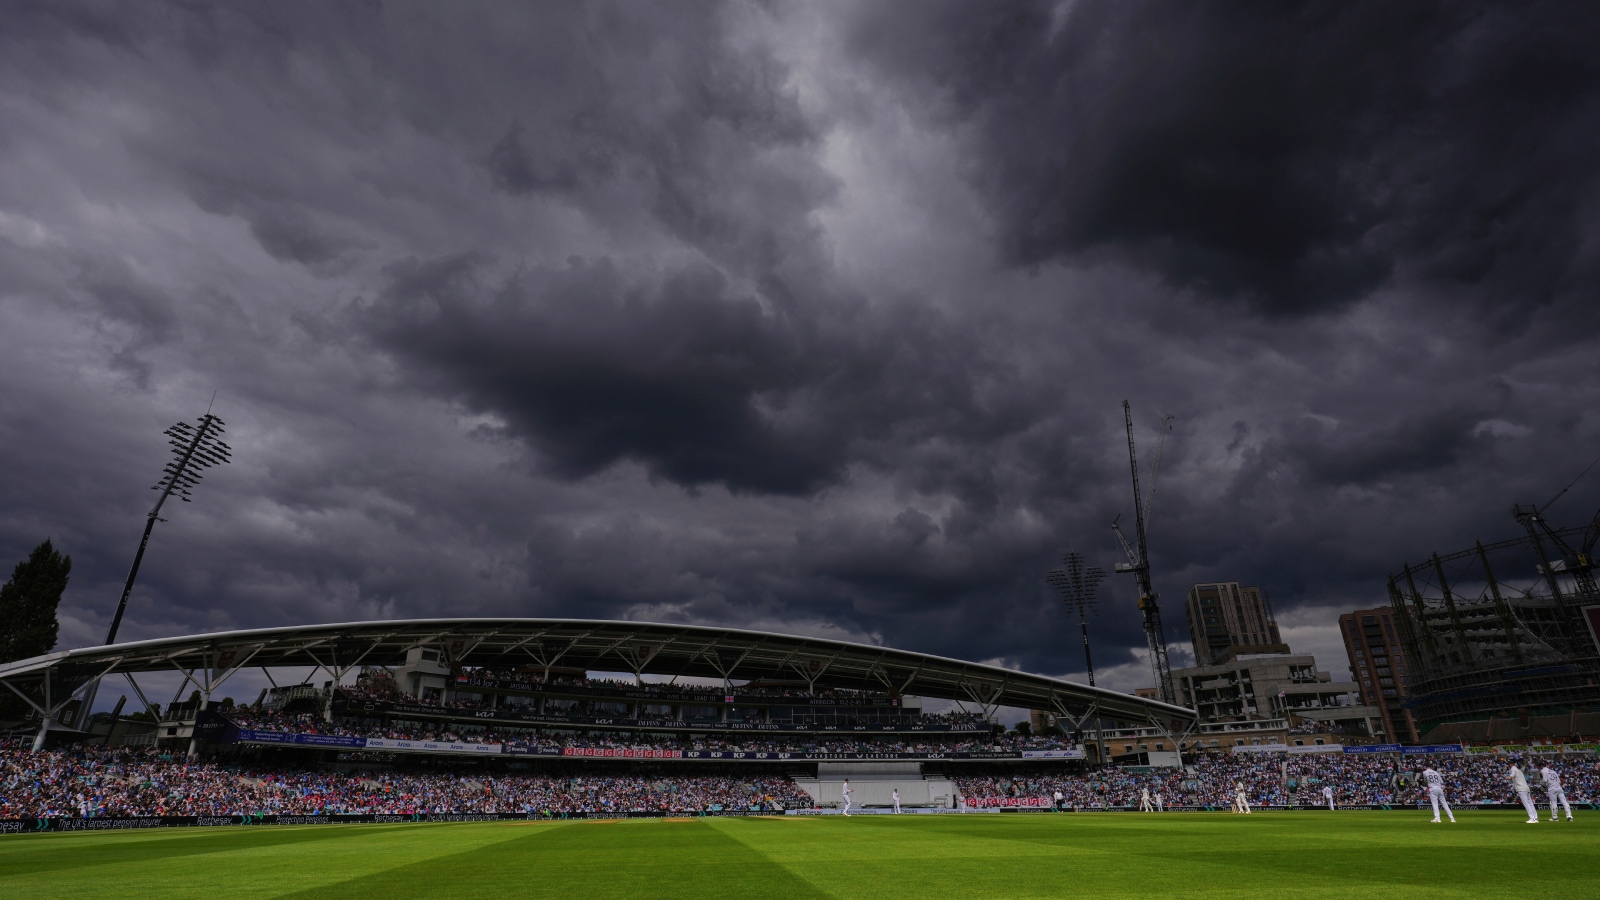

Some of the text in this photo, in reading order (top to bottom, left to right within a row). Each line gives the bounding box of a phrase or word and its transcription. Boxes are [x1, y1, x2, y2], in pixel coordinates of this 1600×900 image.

[469, 678, 481, 686] 134
[483, 679, 493, 688] for
[1428, 775, 1439, 784] 88
[58, 817, 163, 828] The UK's largest pension insurer
[197, 816, 233, 825] Rothesay
